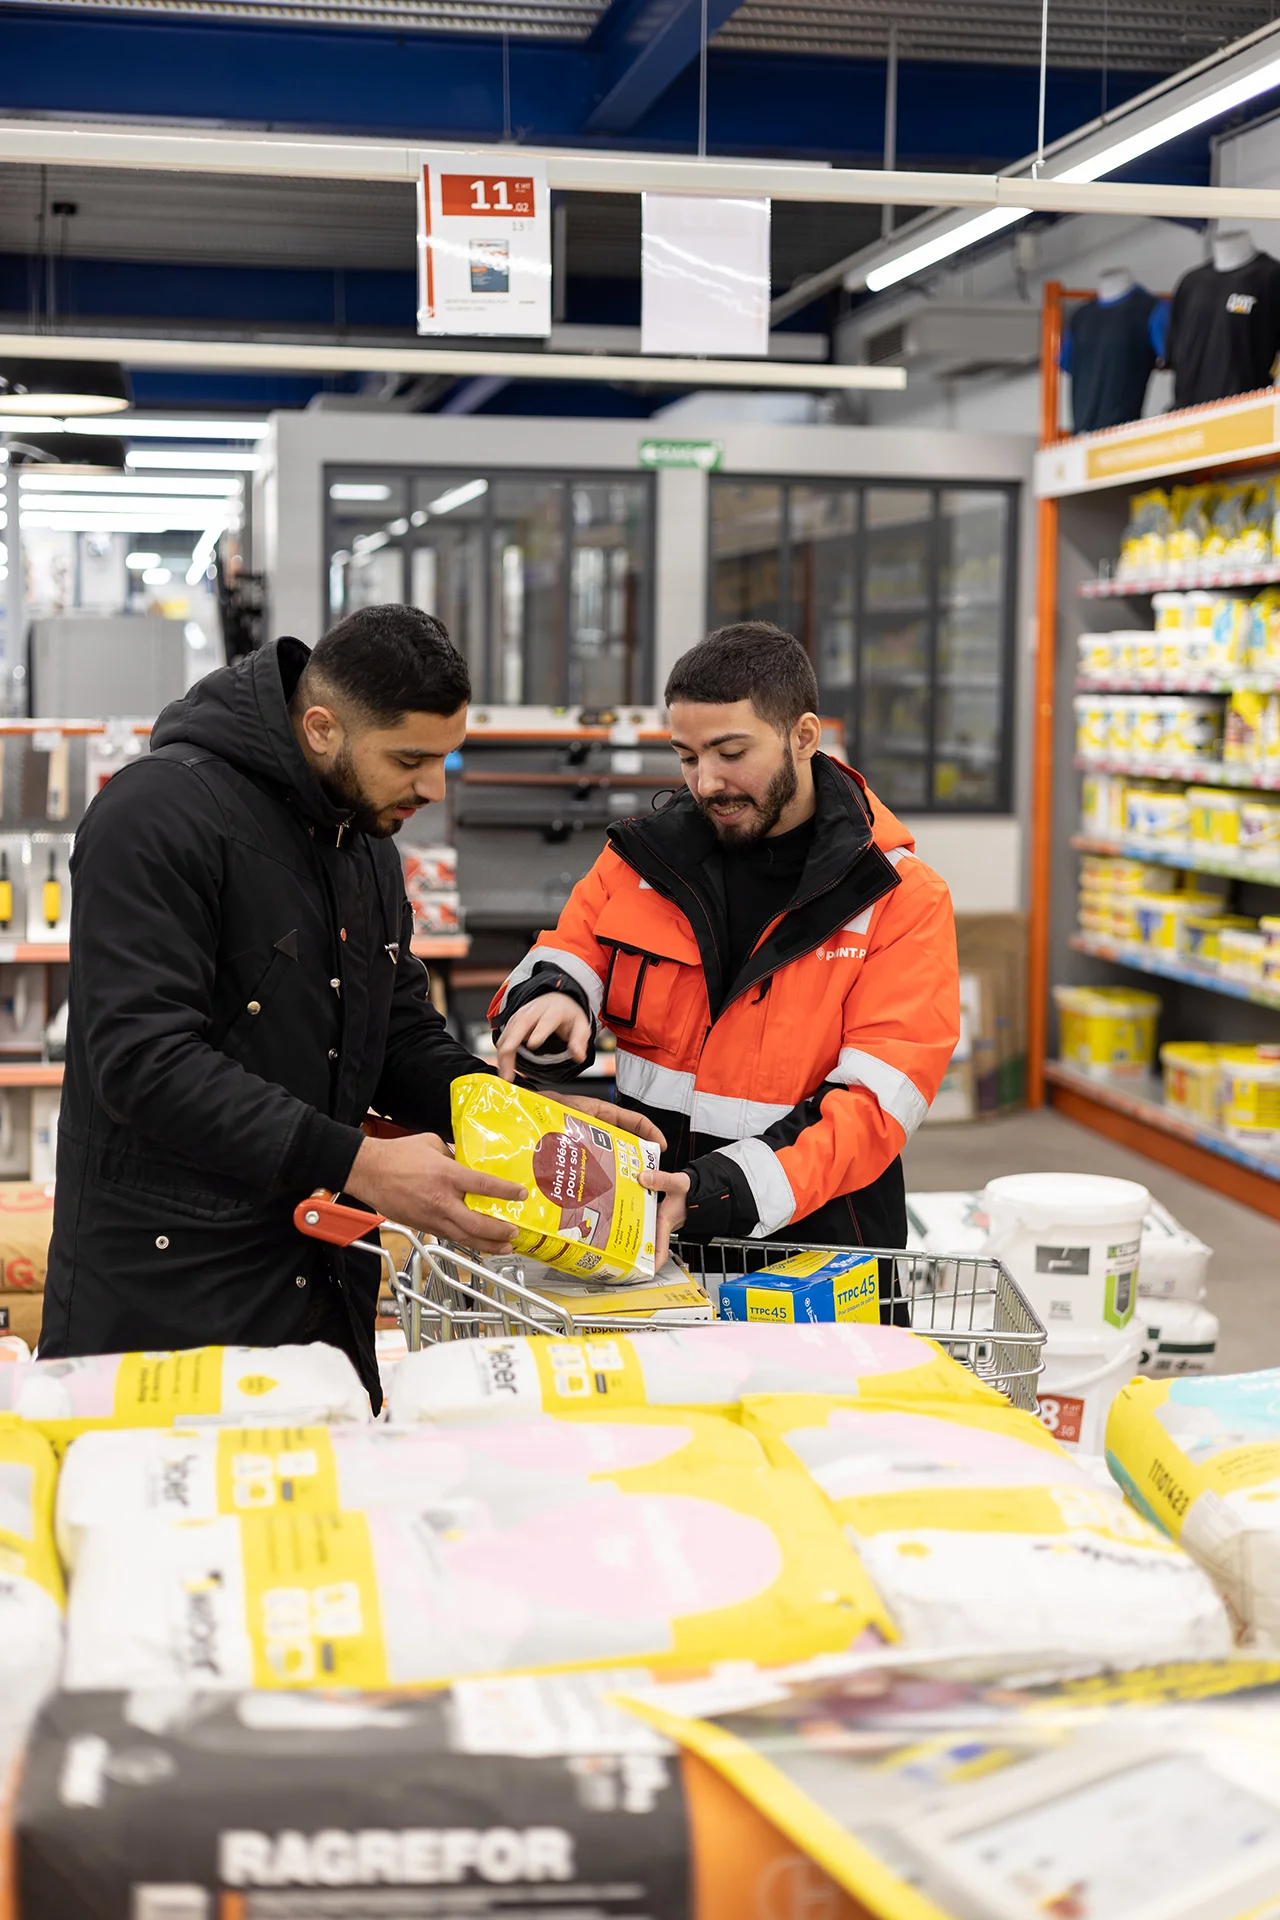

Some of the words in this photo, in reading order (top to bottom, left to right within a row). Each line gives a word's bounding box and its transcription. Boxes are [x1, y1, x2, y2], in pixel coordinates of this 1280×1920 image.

[470, 180, 513, 211] 11
[555, 1135, 567, 1168] idéal
[569, 1145, 578, 1165] sol
[550, 1168, 565, 1201] joint
[566, 1166, 577, 1198] pour
[749, 1306, 788, 1319] TTPC45
[220, 1828, 576, 1885] RAGREFOR
